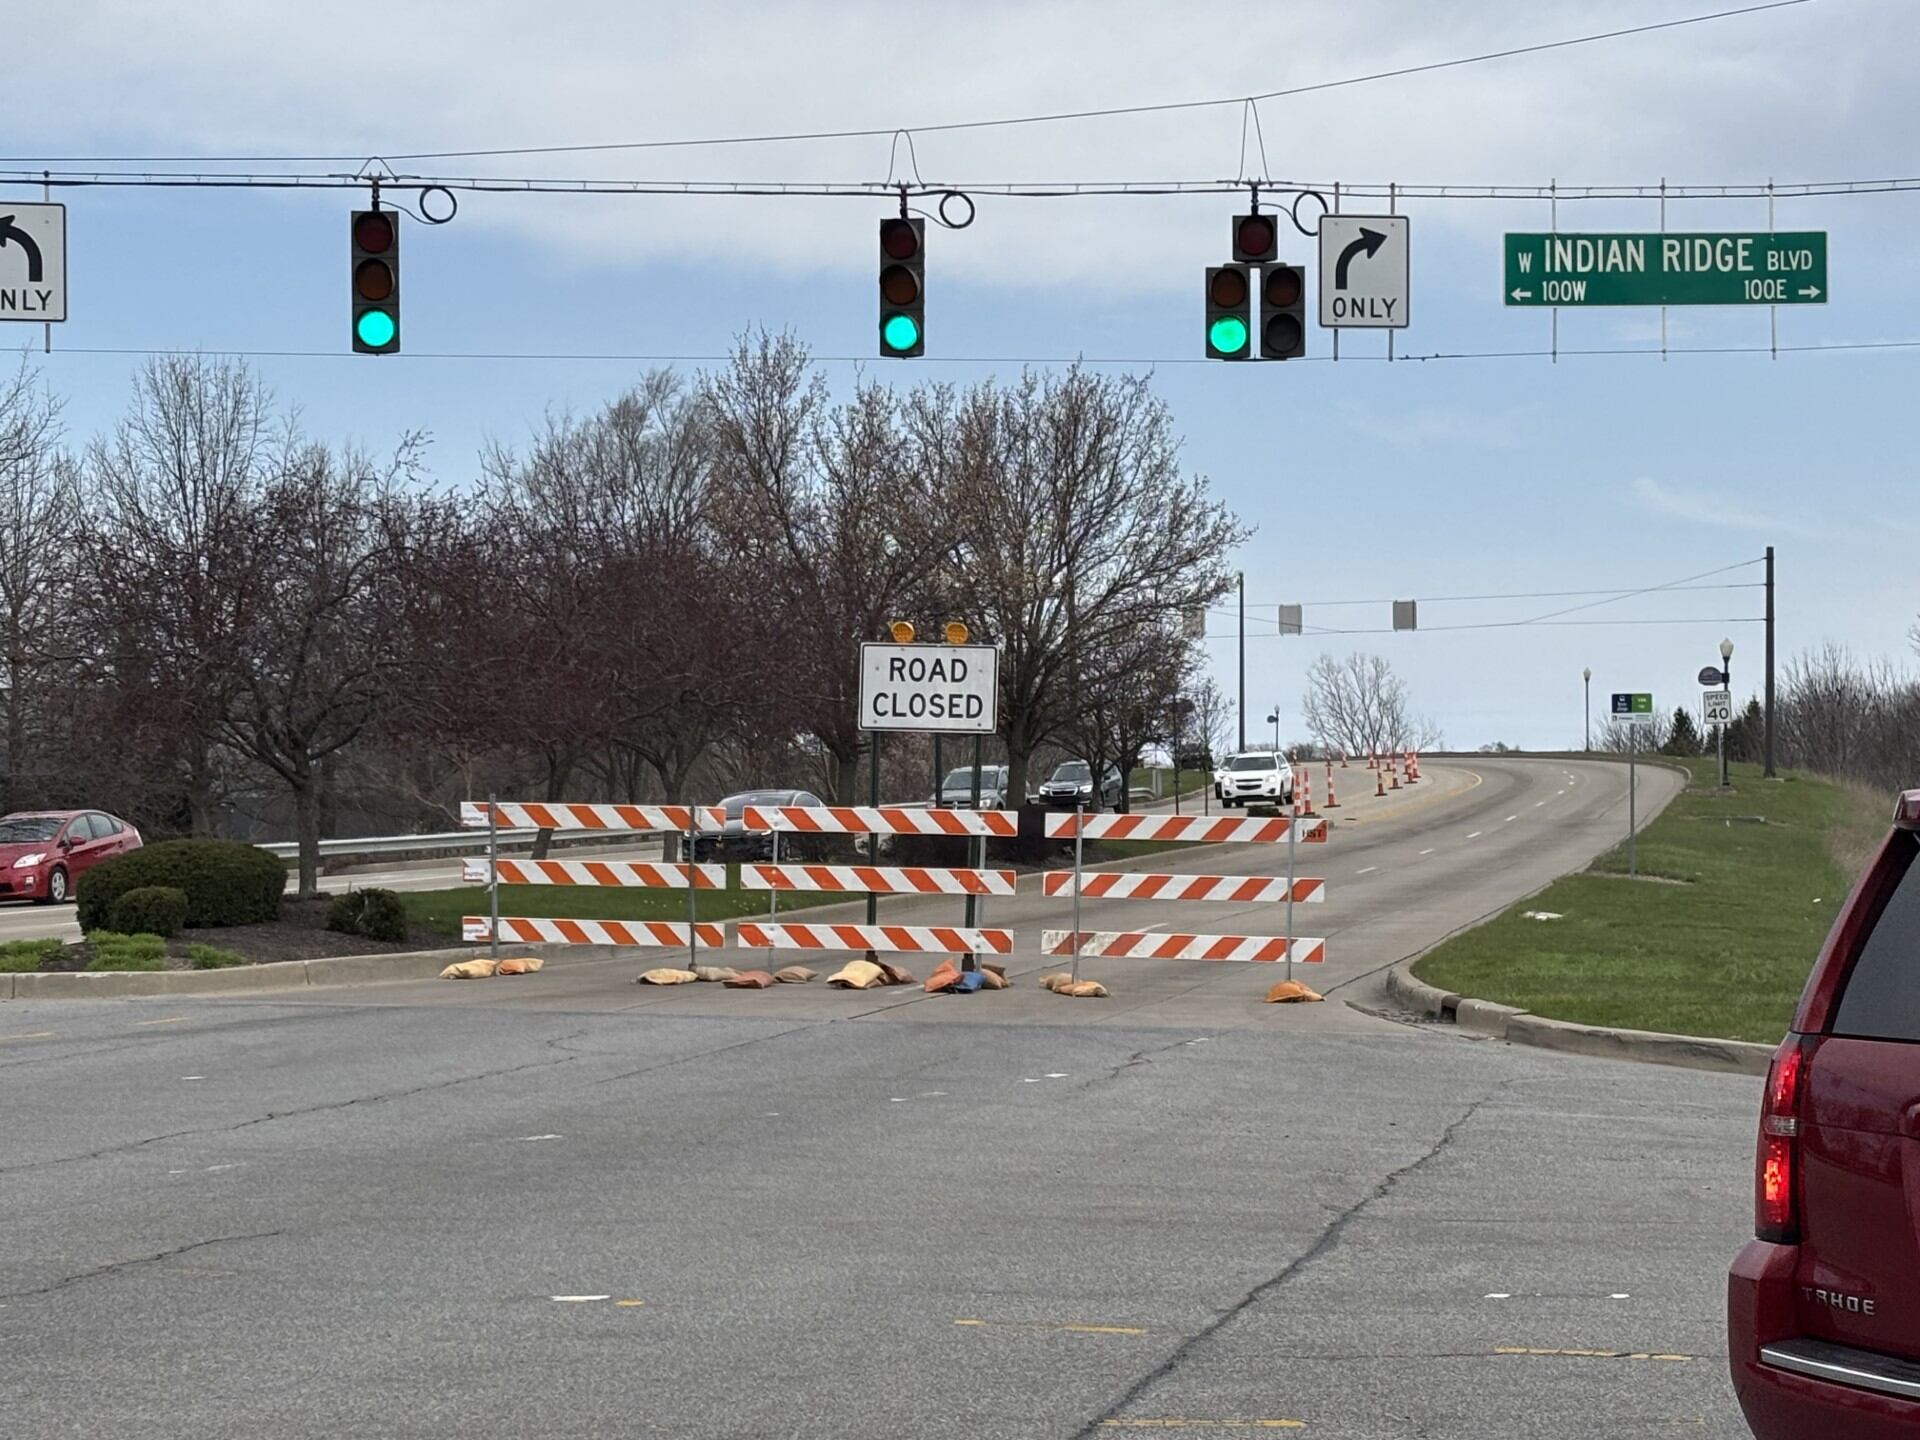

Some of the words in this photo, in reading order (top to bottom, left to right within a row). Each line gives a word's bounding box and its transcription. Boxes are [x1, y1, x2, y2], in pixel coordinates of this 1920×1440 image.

[1518, 252, 1532, 274] W
[1545, 238, 1645, 273] INDIAN
[1662, 237, 1754, 272] RIDGE
[1767, 249, 1813, 272] BLVD
[0, 288, 52, 311] NLY
[1542, 280, 1587, 302] 100W
[1744, 279, 1788, 301] 100E
[1333, 296, 1397, 318] ONLY
[889, 657, 968, 683] ROAD
[872, 692, 983, 719] CLOSED
[1707, 707, 1729, 721] 40
[1801, 1285, 1877, 1316] TAHOE
